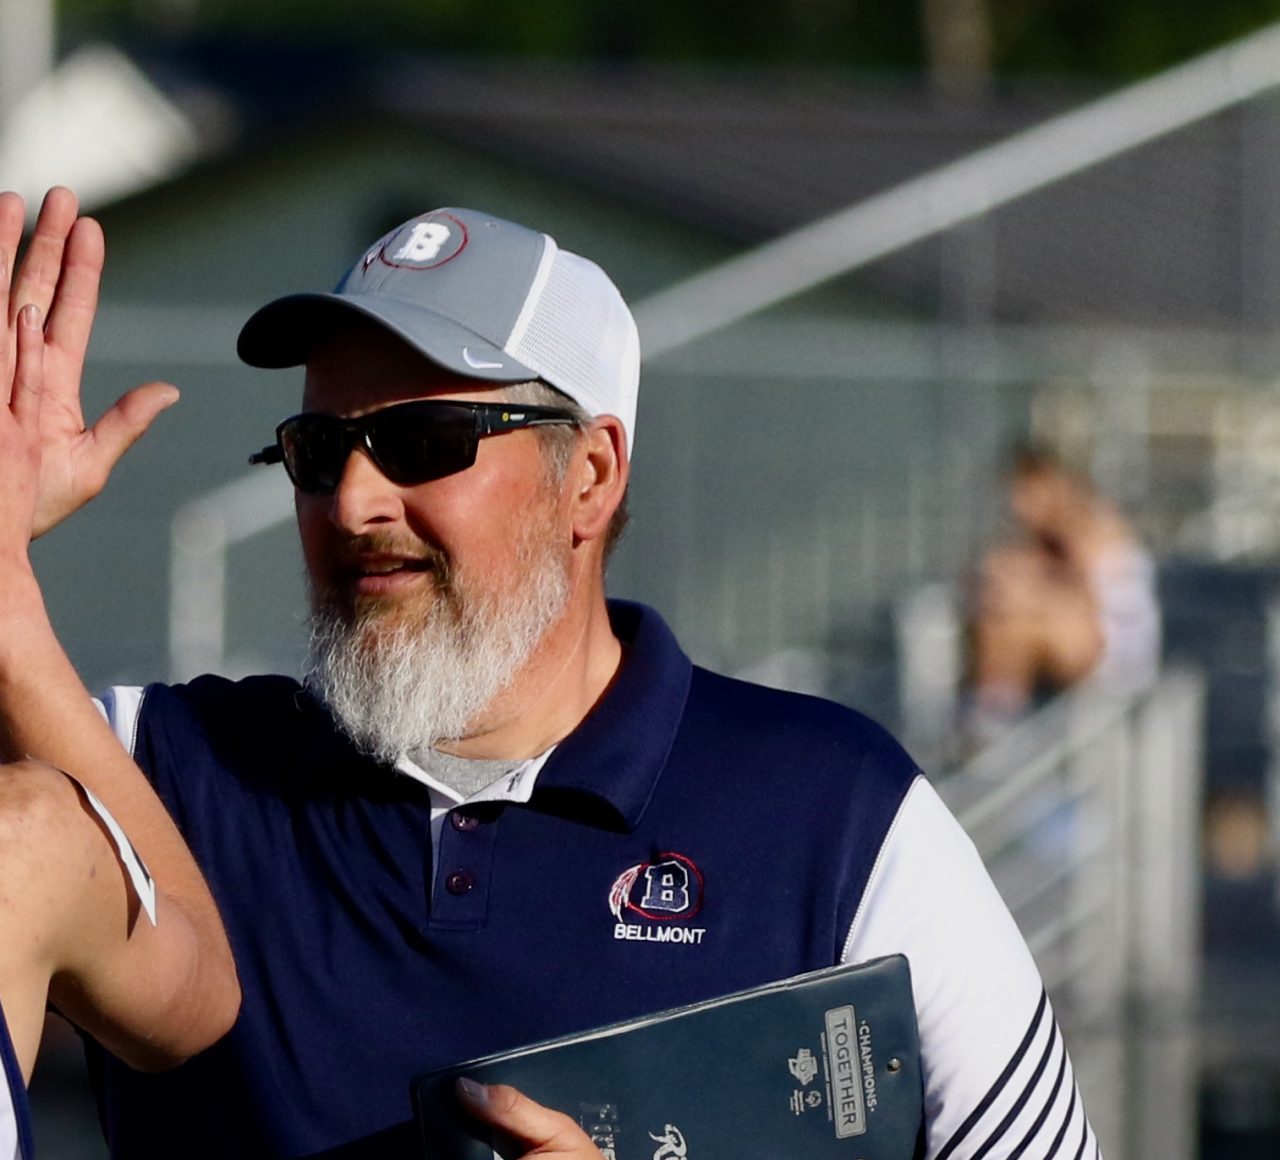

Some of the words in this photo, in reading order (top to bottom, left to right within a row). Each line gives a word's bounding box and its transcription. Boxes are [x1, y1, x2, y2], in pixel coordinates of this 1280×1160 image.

[392, 222, 451, 262] B
[640, 860, 689, 912] B
[614, 923, 706, 944] BELLMONT
[833, 1017, 858, 1126] TOGETHER
